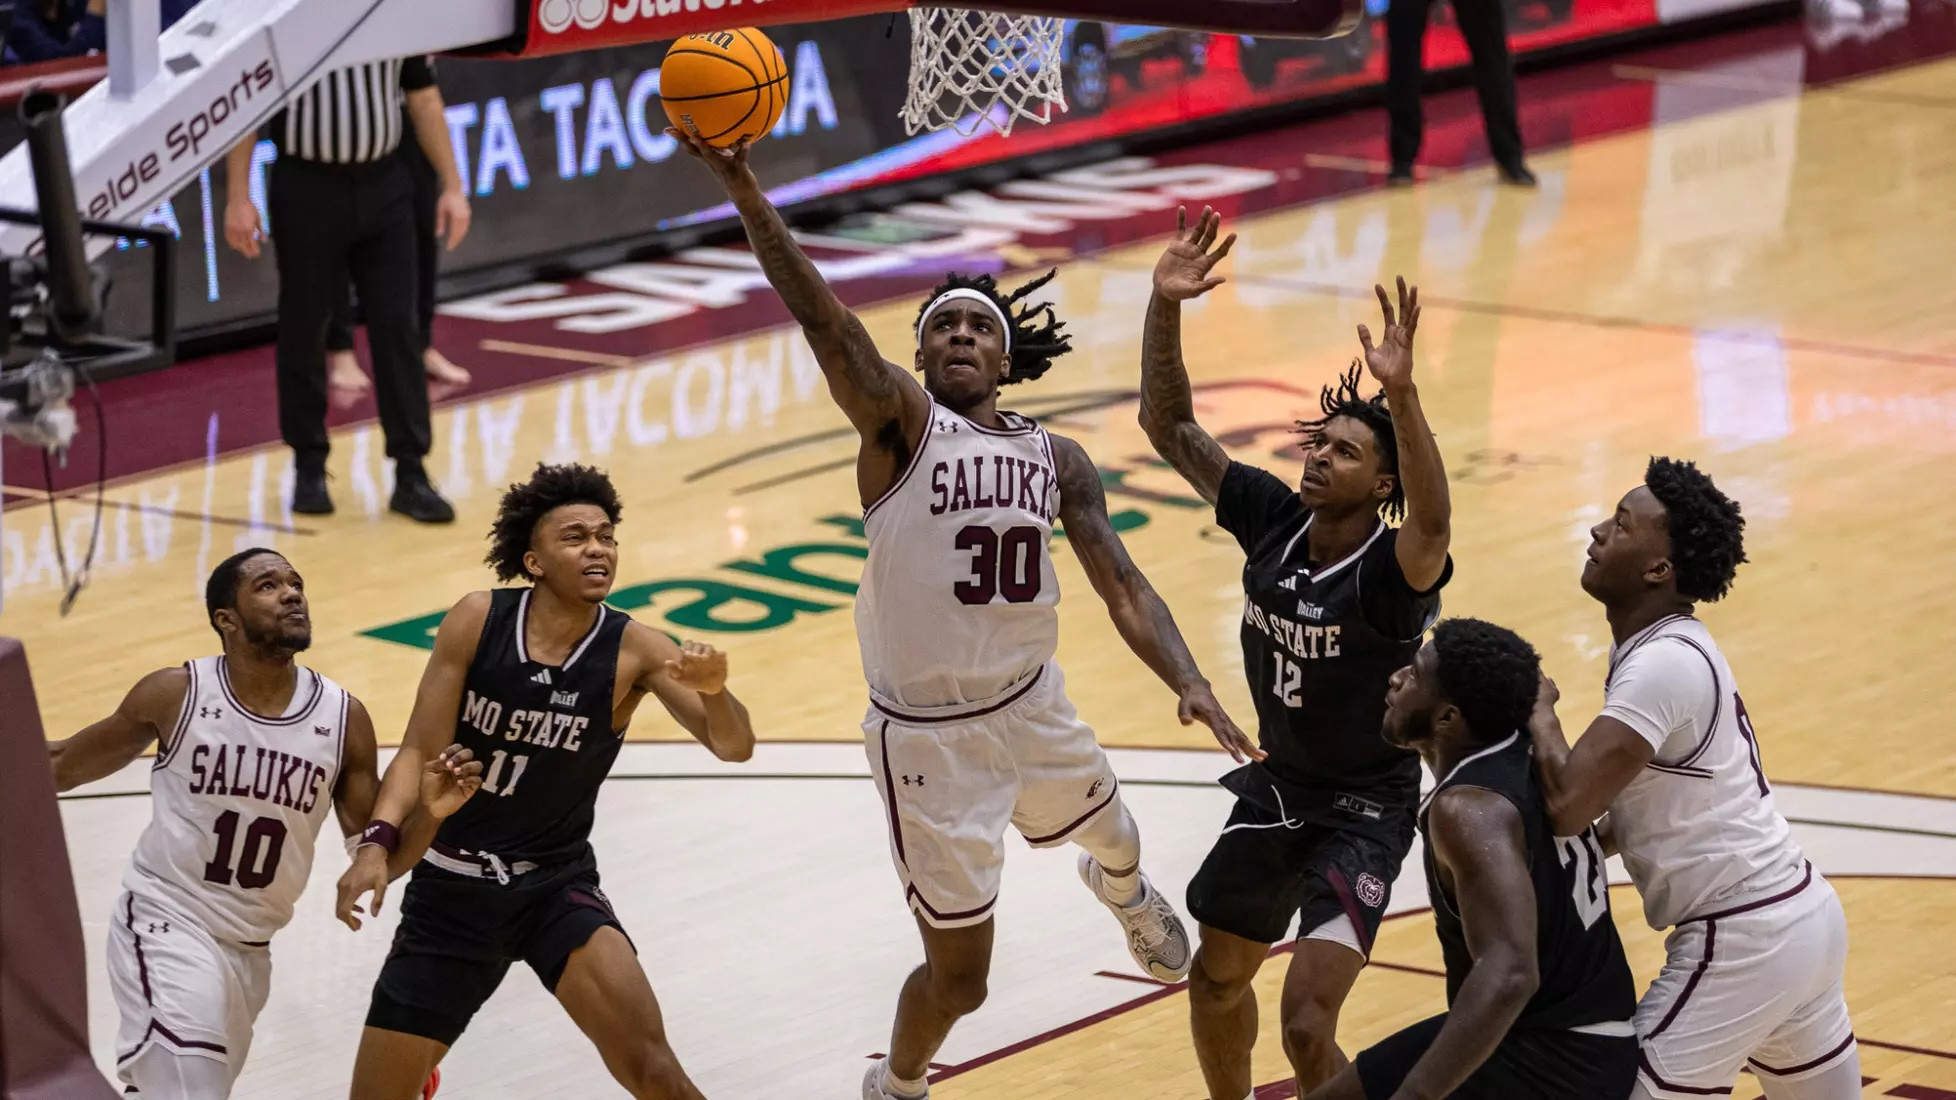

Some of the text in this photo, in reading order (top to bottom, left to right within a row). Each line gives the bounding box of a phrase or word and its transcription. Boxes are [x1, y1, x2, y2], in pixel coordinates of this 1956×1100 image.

[166, 59, 274, 162] Sports
[540, 40, 838, 181] TACA
[954, 525, 1041, 605] 30
[1244, 594, 1340, 659] MO STATE
[1273, 651, 1302, 707] 12
[462, 690, 590, 752] MO STATE
[189, 744, 326, 814] SALUKIS
[481, 750, 529, 797] 11
[204, 809, 288, 889] 10
